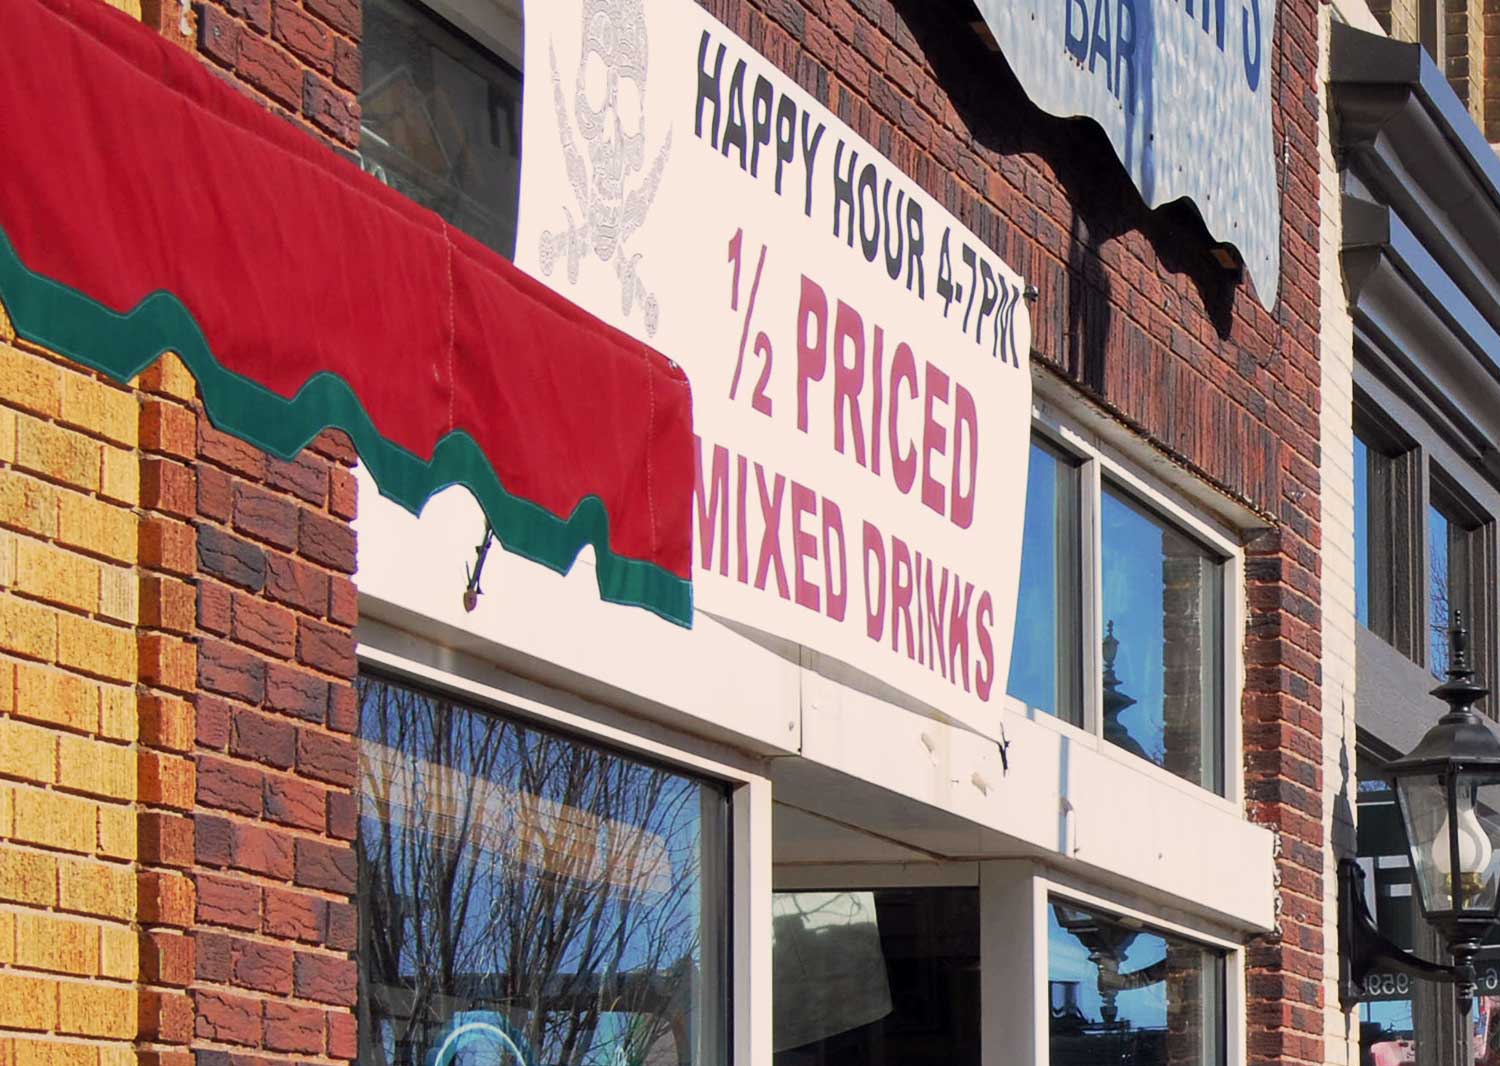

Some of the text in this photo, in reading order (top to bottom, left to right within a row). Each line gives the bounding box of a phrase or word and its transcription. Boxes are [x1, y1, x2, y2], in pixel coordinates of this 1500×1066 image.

[695, 30, 1019, 369] HAPPY HOUR 4-7PM
[797, 273, 979, 529] PRICED
[694, 433, 995, 702] MIXED DRINKS
